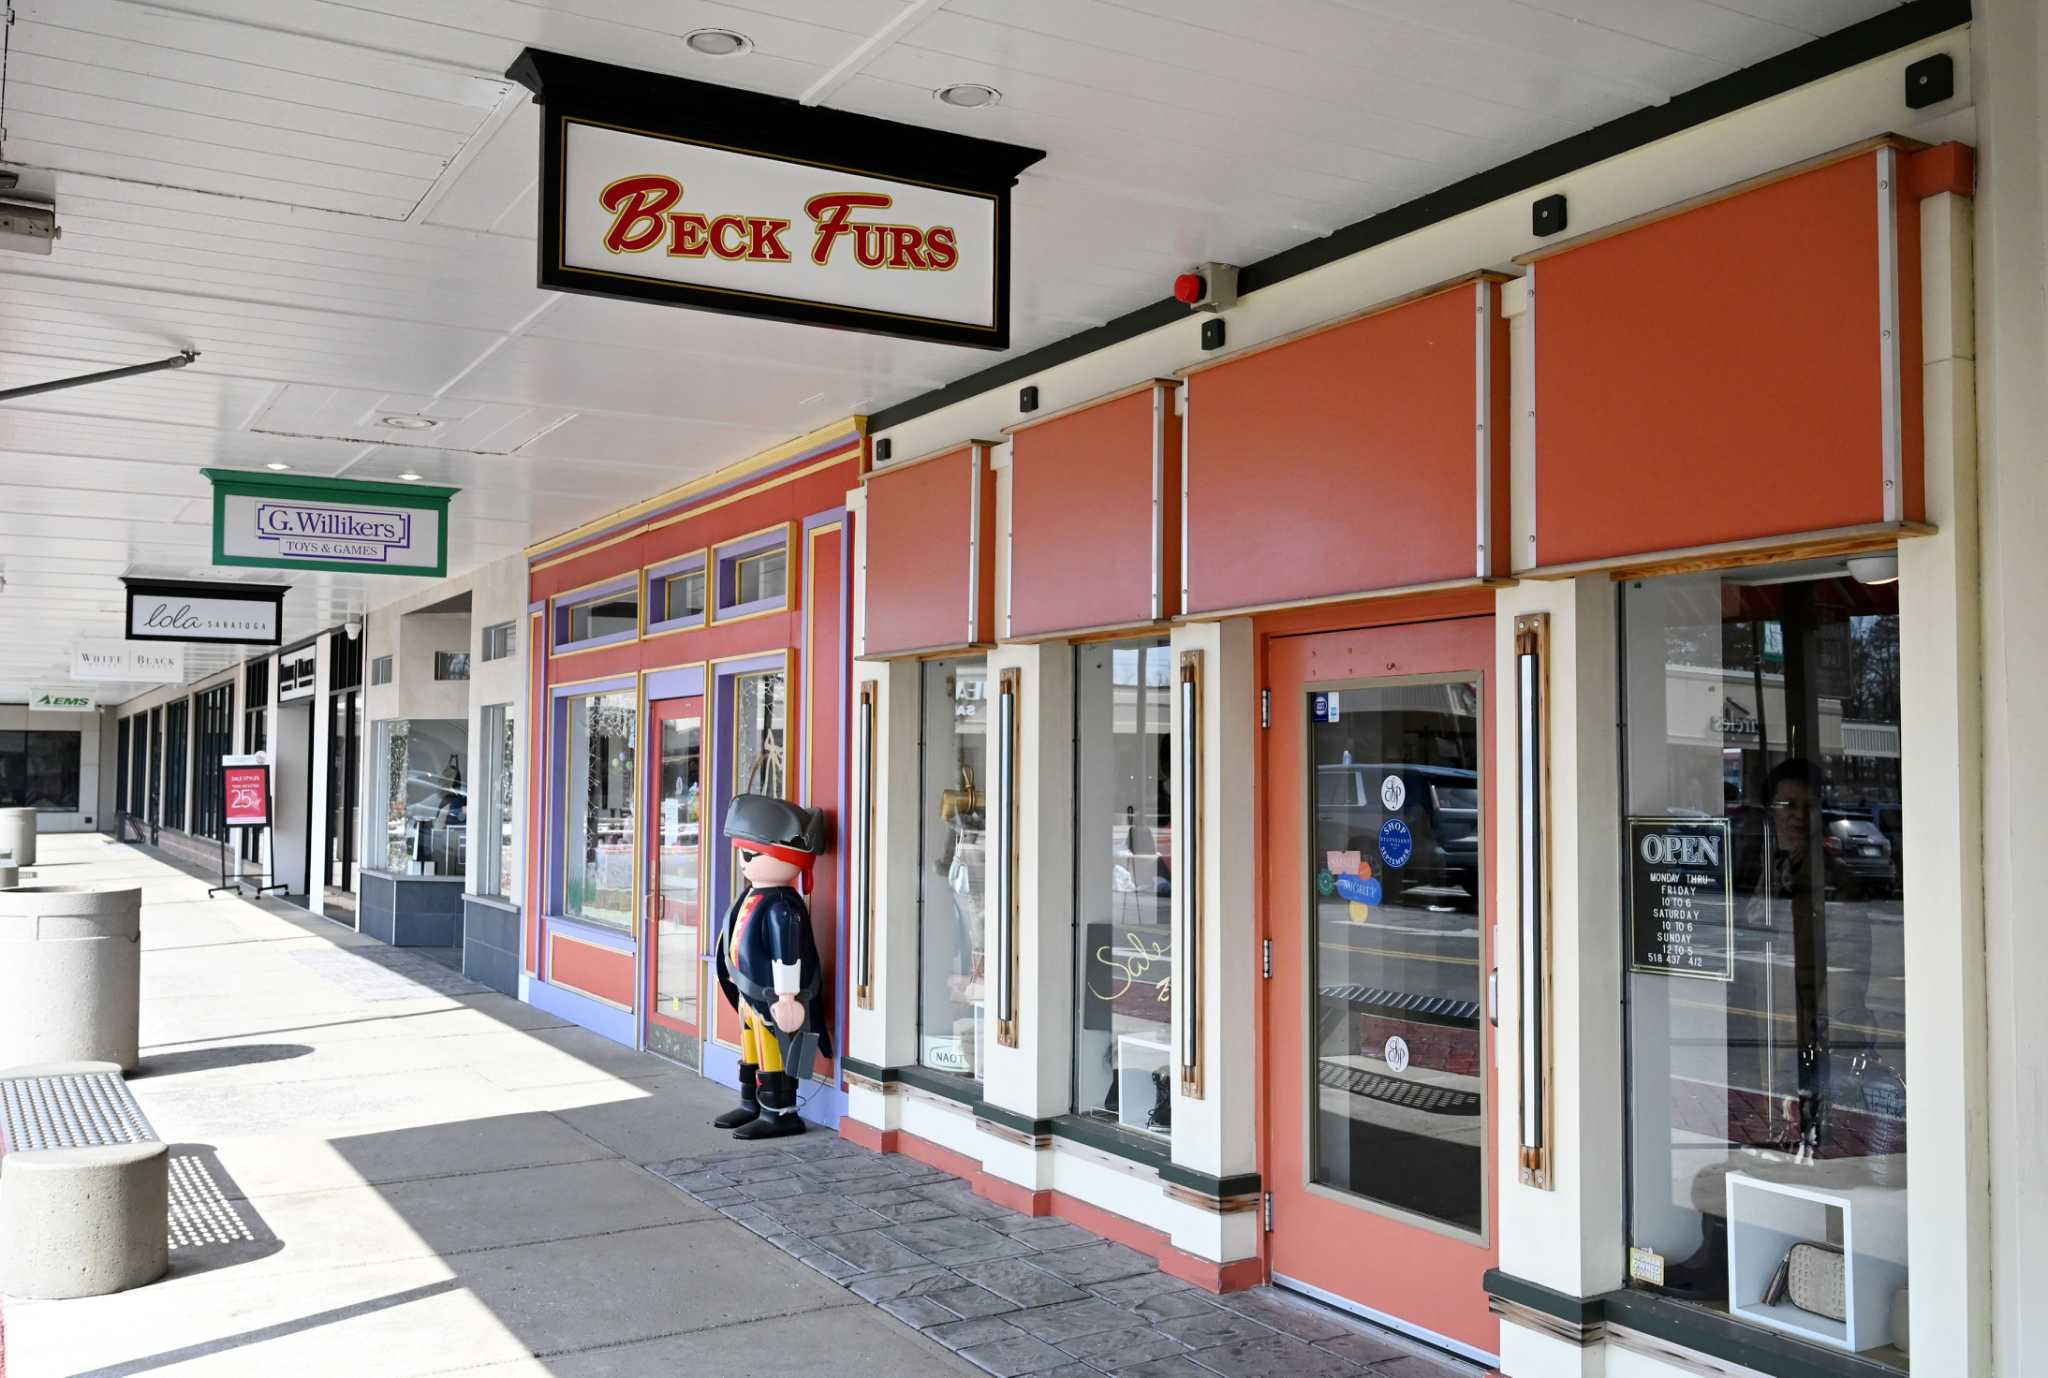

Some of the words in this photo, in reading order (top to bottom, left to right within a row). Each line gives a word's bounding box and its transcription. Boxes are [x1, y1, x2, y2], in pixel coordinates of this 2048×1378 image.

[600, 174, 792, 263] BECK
[804, 191, 959, 272] FURS
[296, 511, 396, 539] Willikers
[286, 541, 319, 552] TOYS
[321, 543, 332, 554] &
[333, 543, 379, 556] GAMES
[144, 603, 202, 630] lola
[207, 620, 266, 631] SARATOGA
[1641, 834, 1720, 866] OPEN
[1650, 872, 1680, 883] MONDAY
[1661, 885, 1697, 896] FRIDAY
[1662, 897, 1670, 907] 10
[1673, 898, 1683, 908] TO
[1652, 908, 1700, 920] SATURDAY
[1662, 920, 1671, 931] 10
[1675, 921, 1685, 932] TO
[1656, 932, 1693, 945] SUNDAY
[1648, 952, 1663, 964] 518
